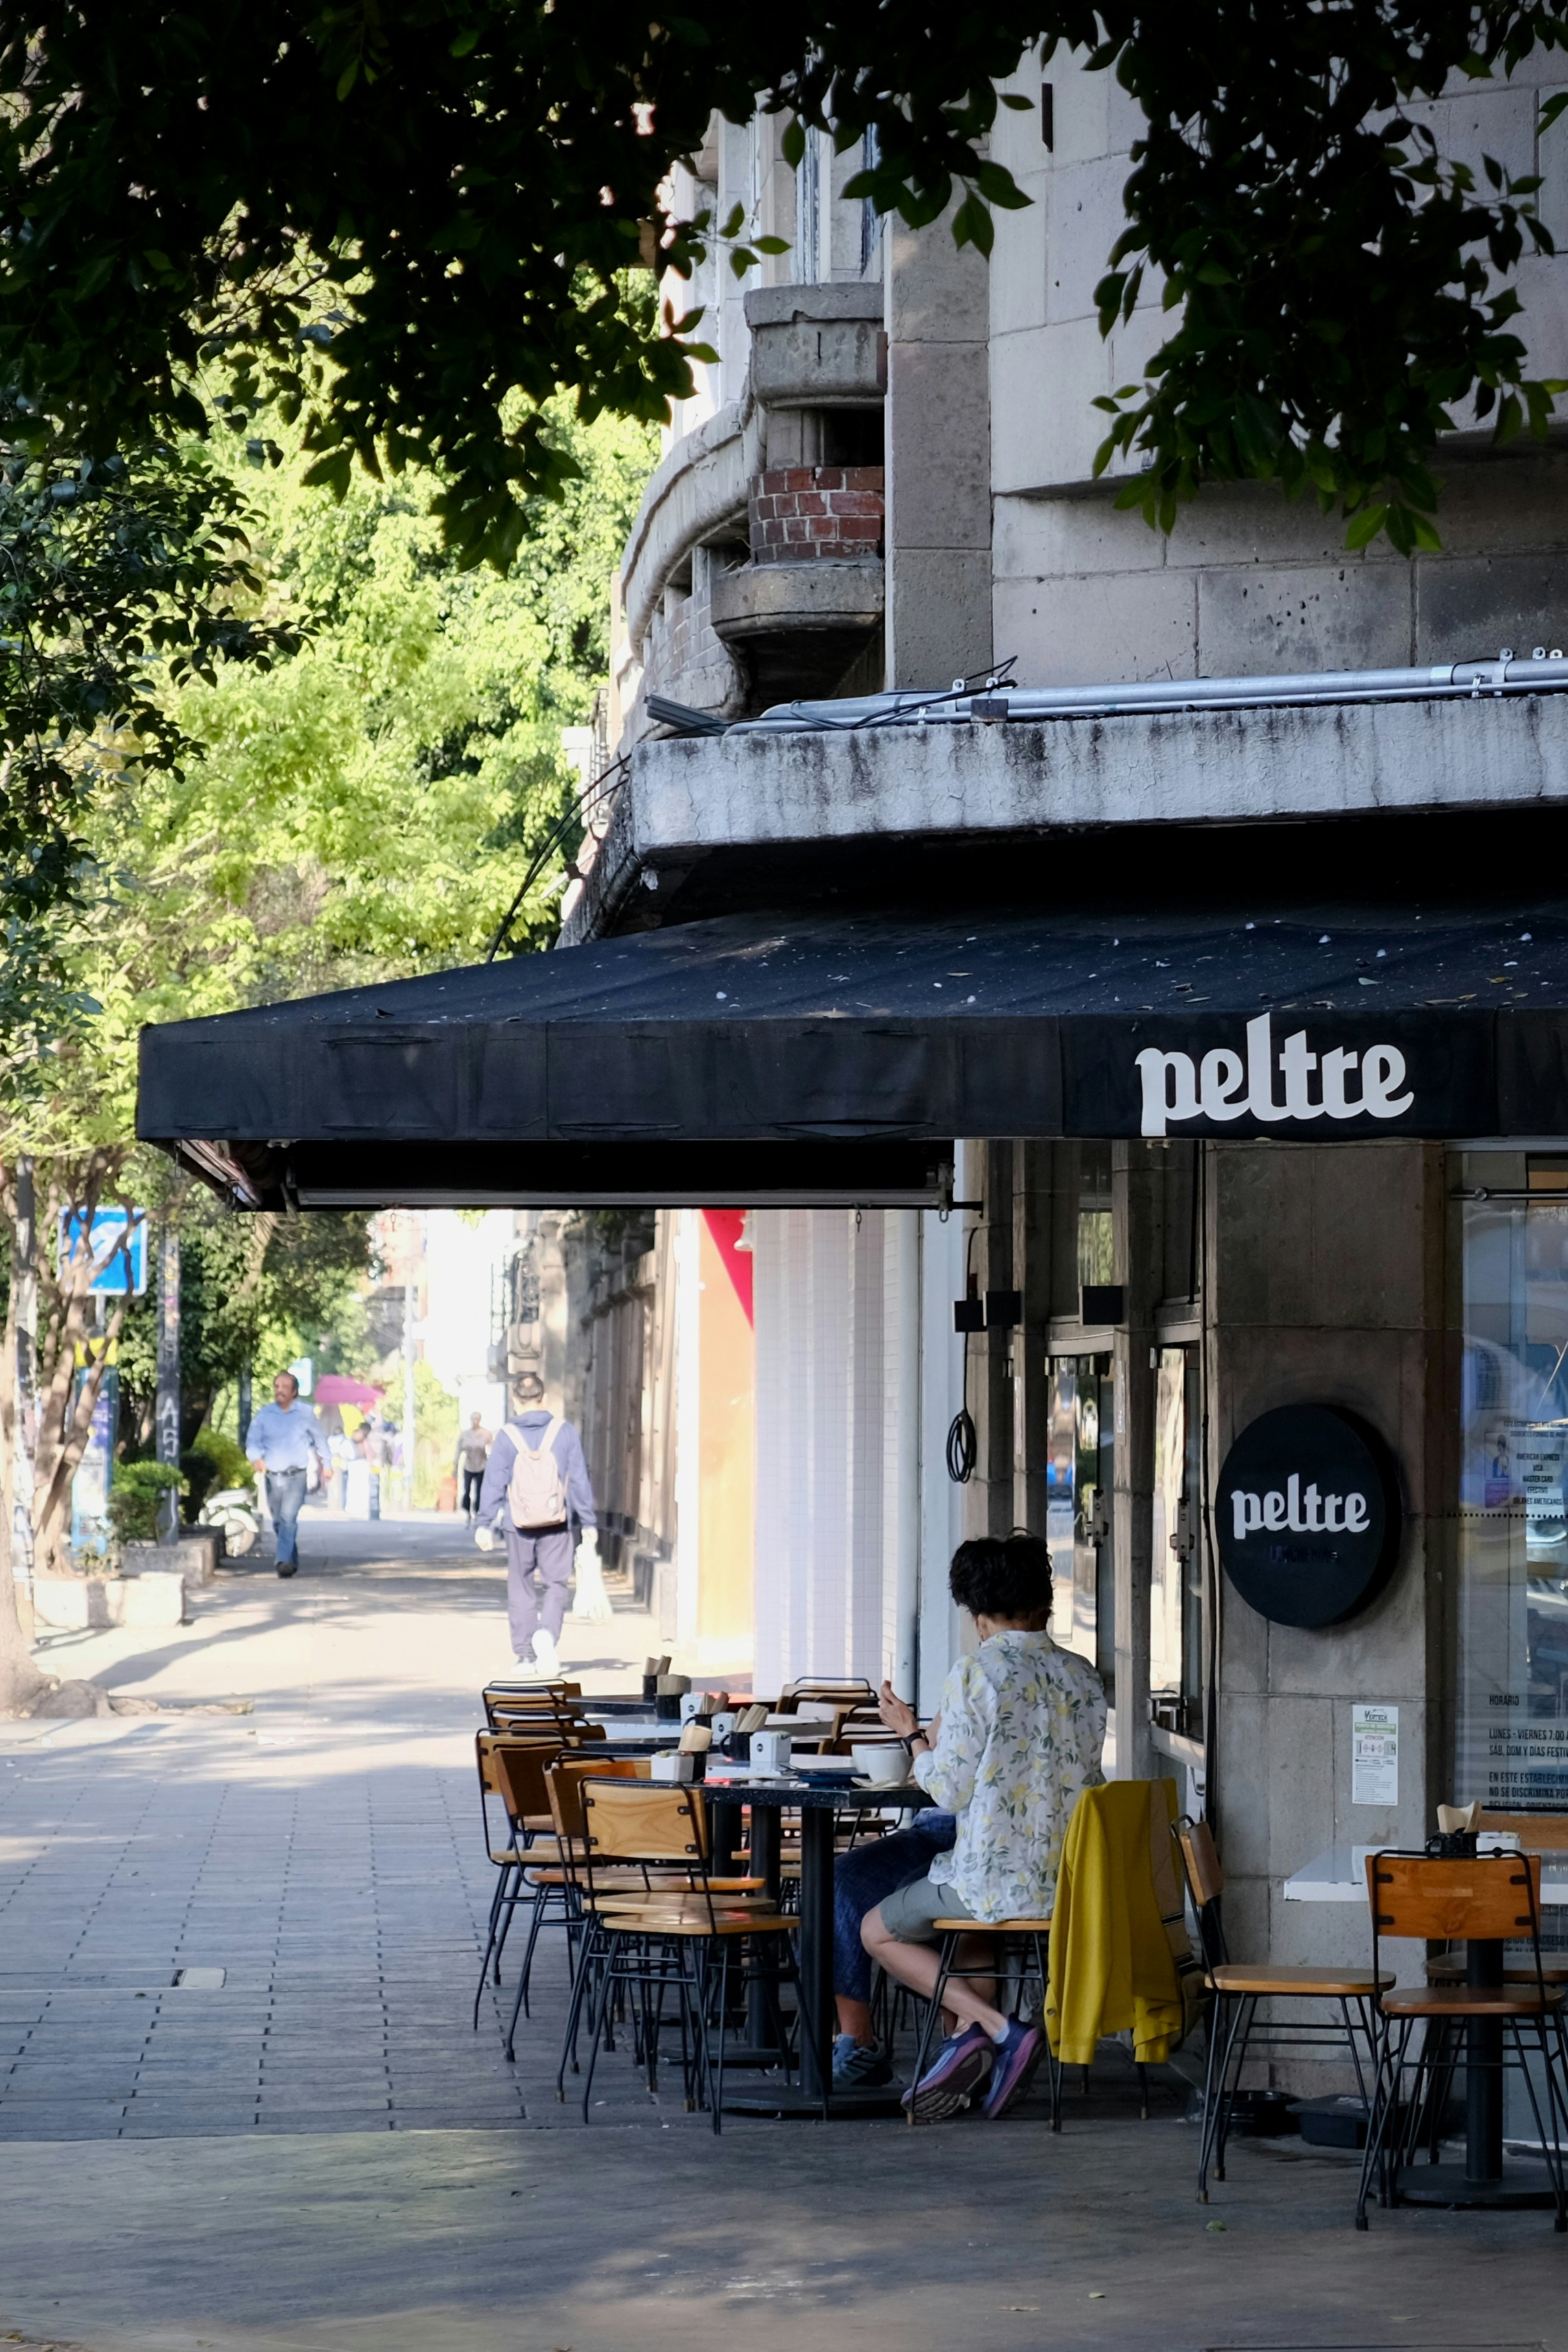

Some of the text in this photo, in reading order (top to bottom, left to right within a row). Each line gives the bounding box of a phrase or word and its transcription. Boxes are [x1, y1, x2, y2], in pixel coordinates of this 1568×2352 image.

[1134, 1011, 1414, 1137] peltre
[1231, 1472, 1370, 1540] peltre
[1489, 1695, 1519, 1706] HORARIO
[1489, 1728, 1511, 1739] LUNES
[1517, 1729, 1547, 1740] VIERNES
[1549, 1730, 1565, 1741] 7:00
[1506, 1746, 1521, 1757] DOM
[1523, 1746, 1528, 1757] Y
[1529, 1744, 1545, 1757] DÍAS
[1489, 1772, 1499, 1783] EN
[1501, 1772, 1518, 1783] ESTE
[1489, 1786, 1499, 1797] NO
[1501, 1787, 1510, 1797] SE
[1512, 1787, 1554, 1798] DISCRIMINA
